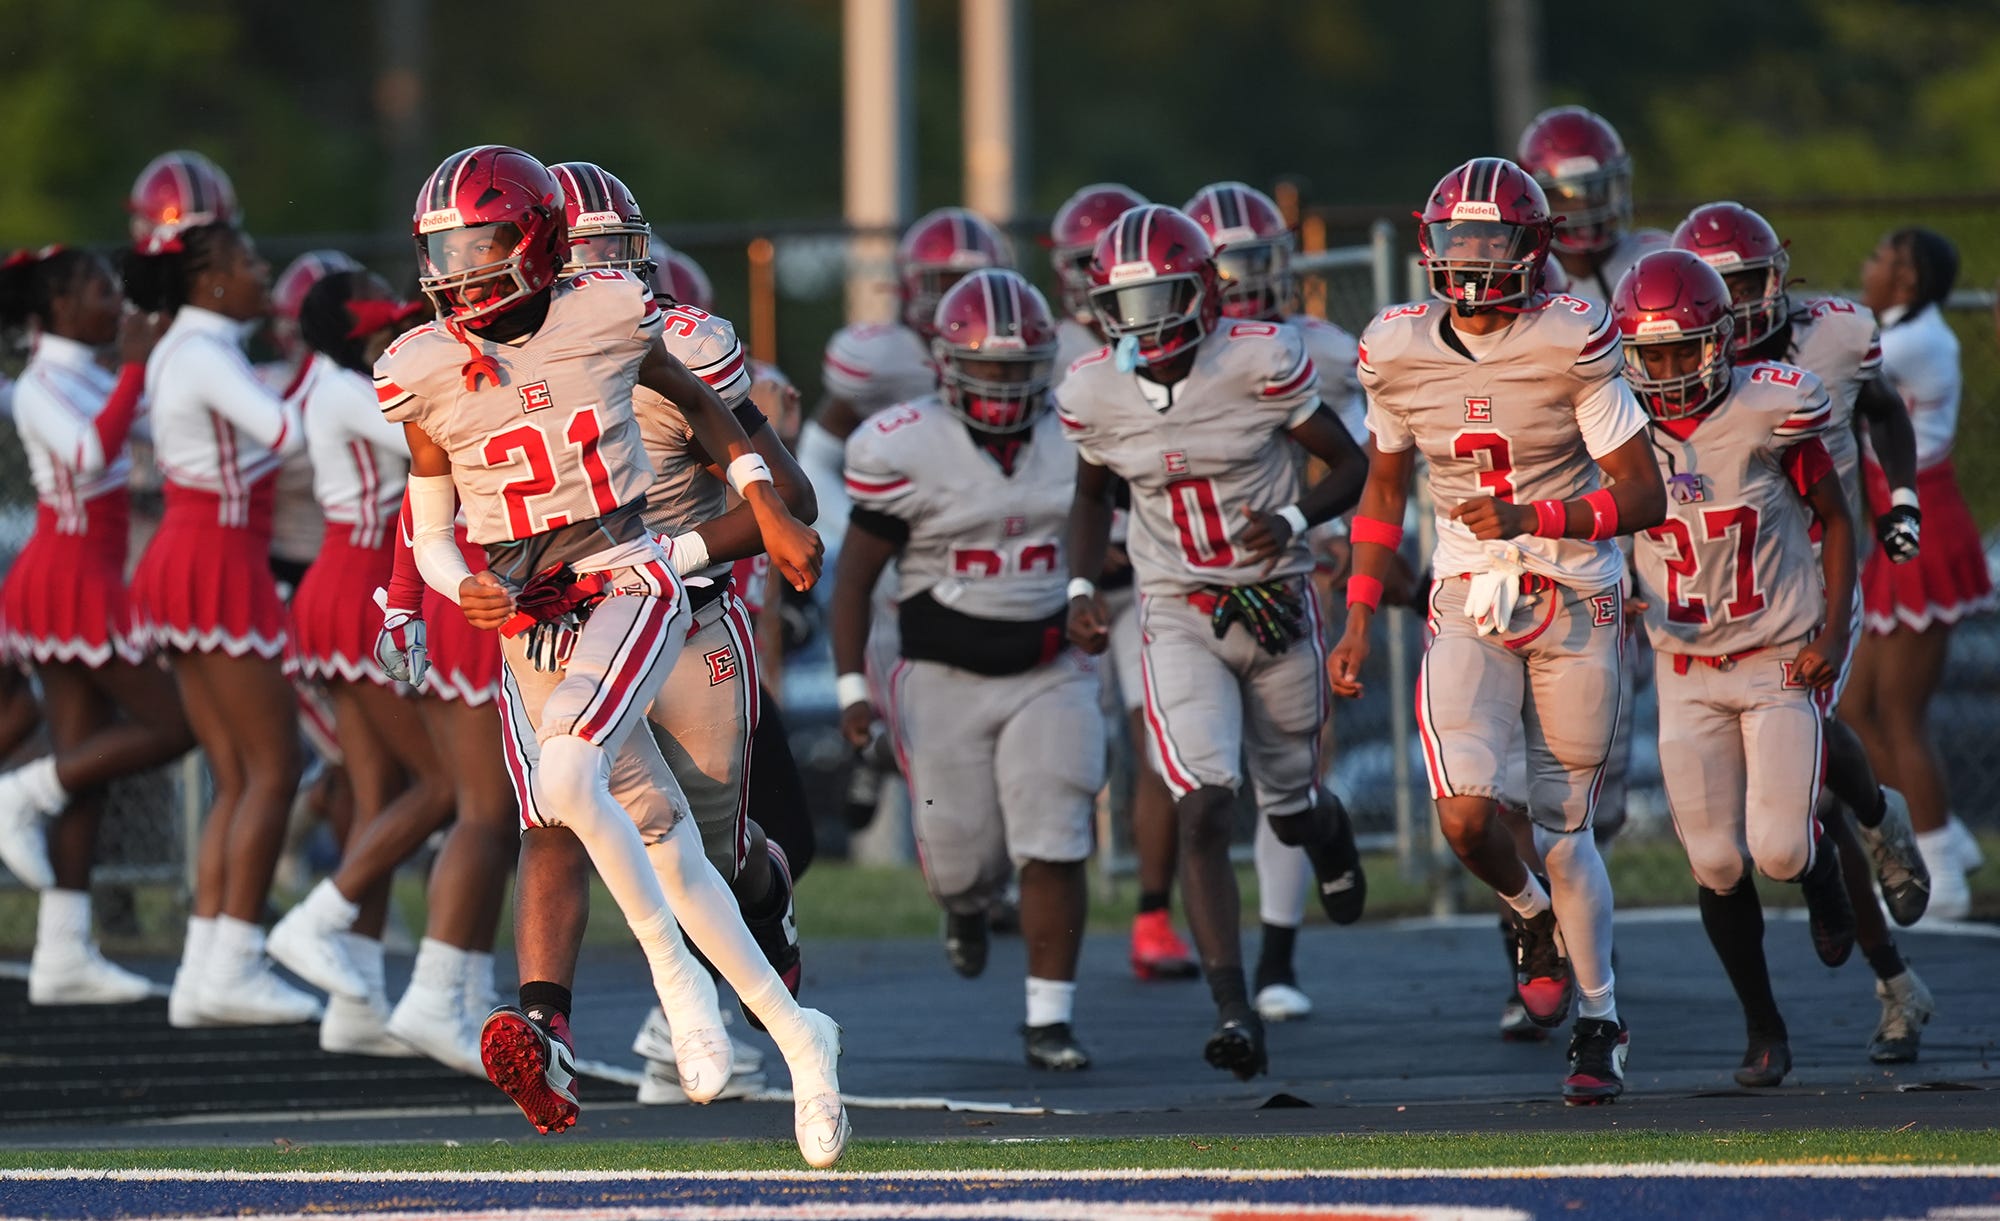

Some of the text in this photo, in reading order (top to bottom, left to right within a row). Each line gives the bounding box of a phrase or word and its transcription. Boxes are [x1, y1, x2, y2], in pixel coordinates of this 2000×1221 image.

[422, 213, 457, 228] Riddell
[1456, 205, 1498, 217] Riddell
[1381, 303, 1430, 323] 3
[517, 379, 554, 414] E
[1464, 396, 1493, 423] E
[479, 403, 622, 541] 21
[1161, 449, 1191, 477] E
[1450, 427, 1518, 505] 3
[1164, 477, 1236, 573] 0
[1643, 502, 1769, 629] 27
[1590, 592, 1618, 628] E
[703, 643, 738, 687] E
